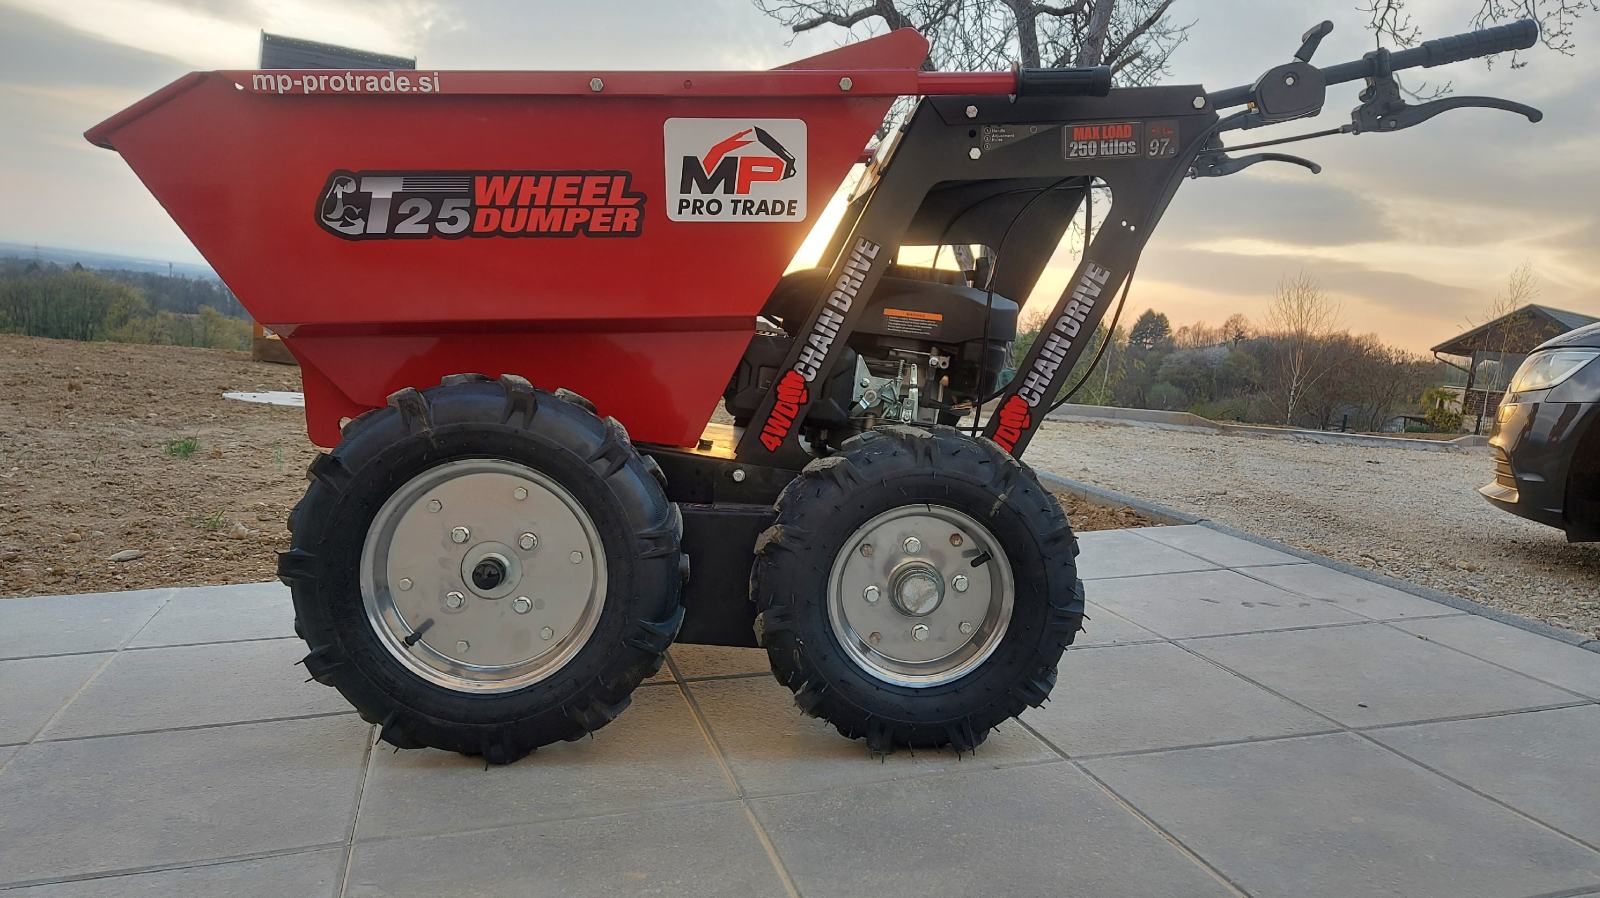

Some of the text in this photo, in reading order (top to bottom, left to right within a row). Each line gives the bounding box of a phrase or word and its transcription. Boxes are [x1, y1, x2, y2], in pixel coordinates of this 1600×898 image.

[252, 71, 440, 94] mp-protrade.si
[1073, 124, 1132, 140] MAX LOAD
[1069, 138, 1136, 158] 250 kilos
[1149, 138, 1170, 156] 97
[680, 155, 785, 195] MP
[474, 175, 644, 206] WHEEL
[678, 198, 798, 216] PRO TRADE
[473, 207, 641, 233] DUMPER
[759, 236, 880, 452] 4WD CHAIN DRIVE
[1018, 262, 1111, 408] CHAIN DRIVE
